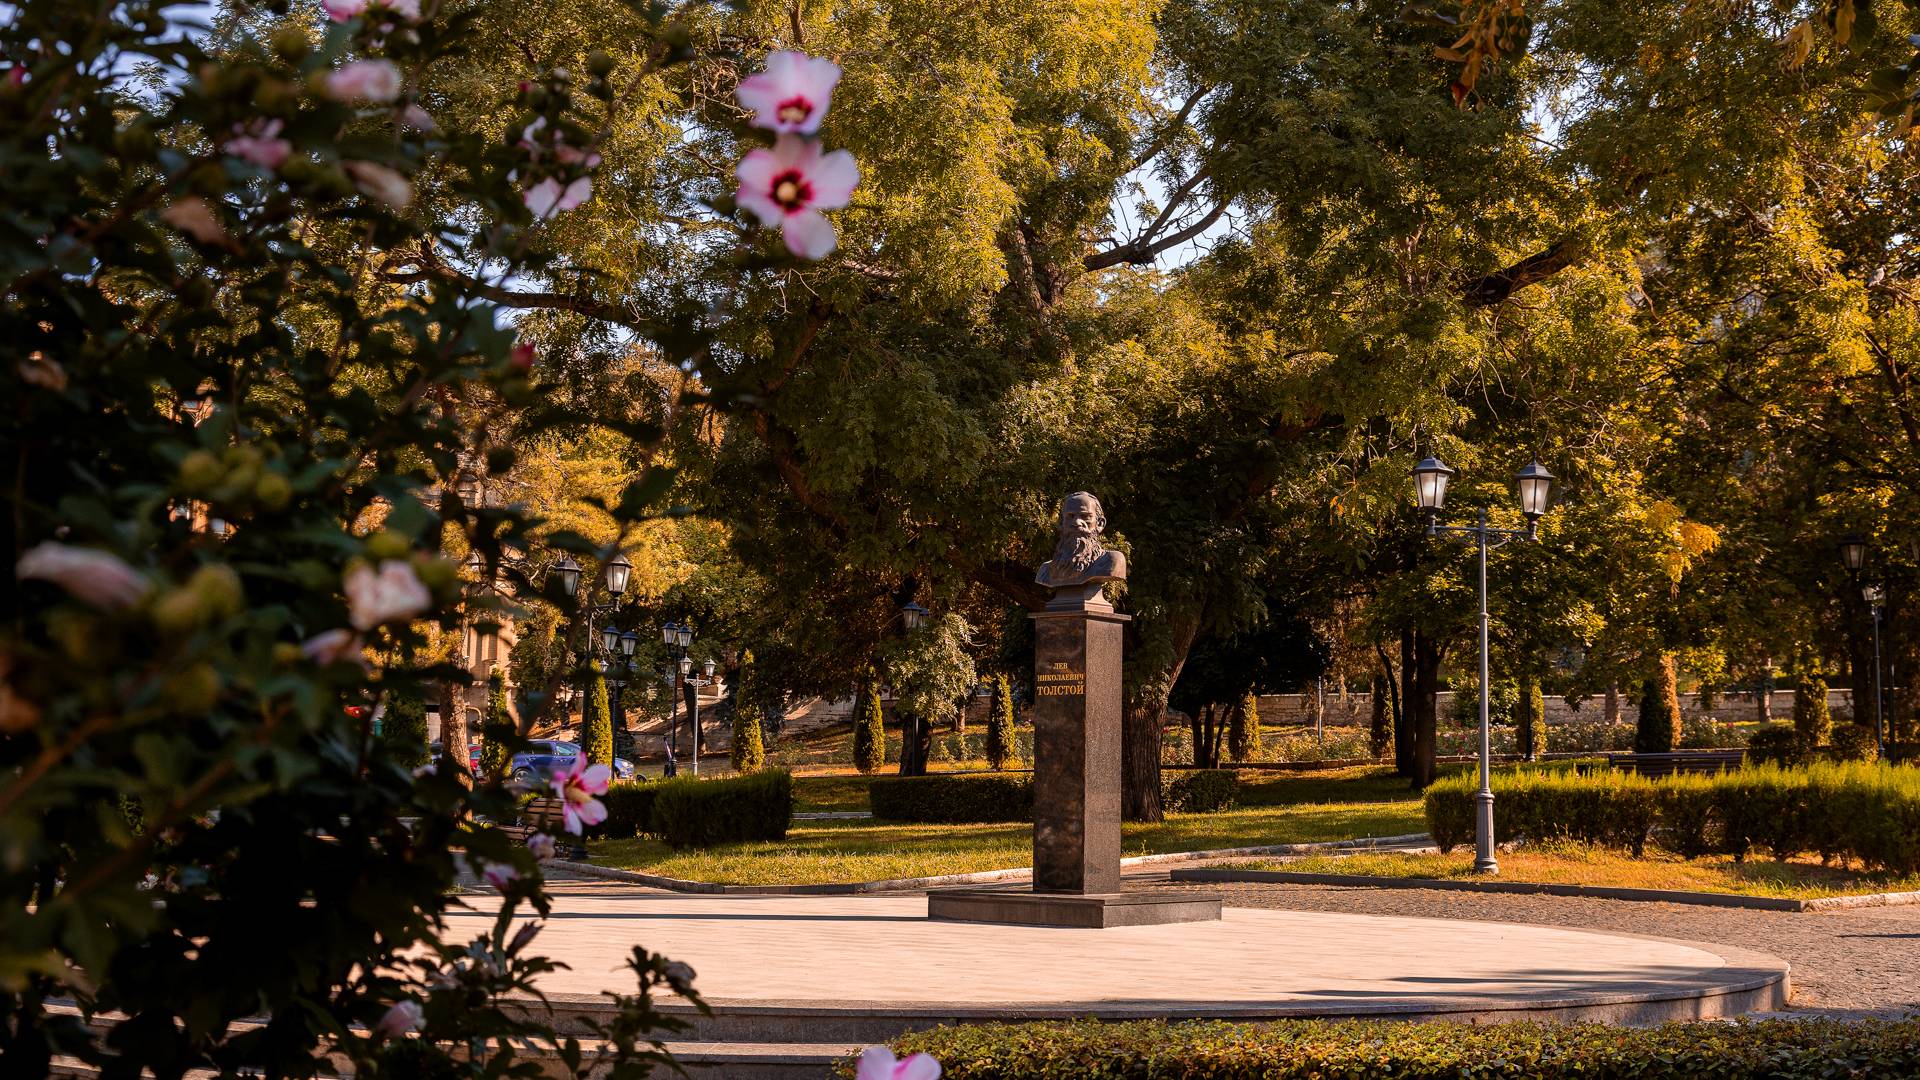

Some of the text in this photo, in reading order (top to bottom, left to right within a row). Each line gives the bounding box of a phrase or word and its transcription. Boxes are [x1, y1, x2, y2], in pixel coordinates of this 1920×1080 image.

[1053, 662, 1068, 670] ЛЕВ
[1037, 673, 1084, 682] НИКОЛАЕВИЧ
[1037, 681, 1085, 696] ТОЛСТОЙ
